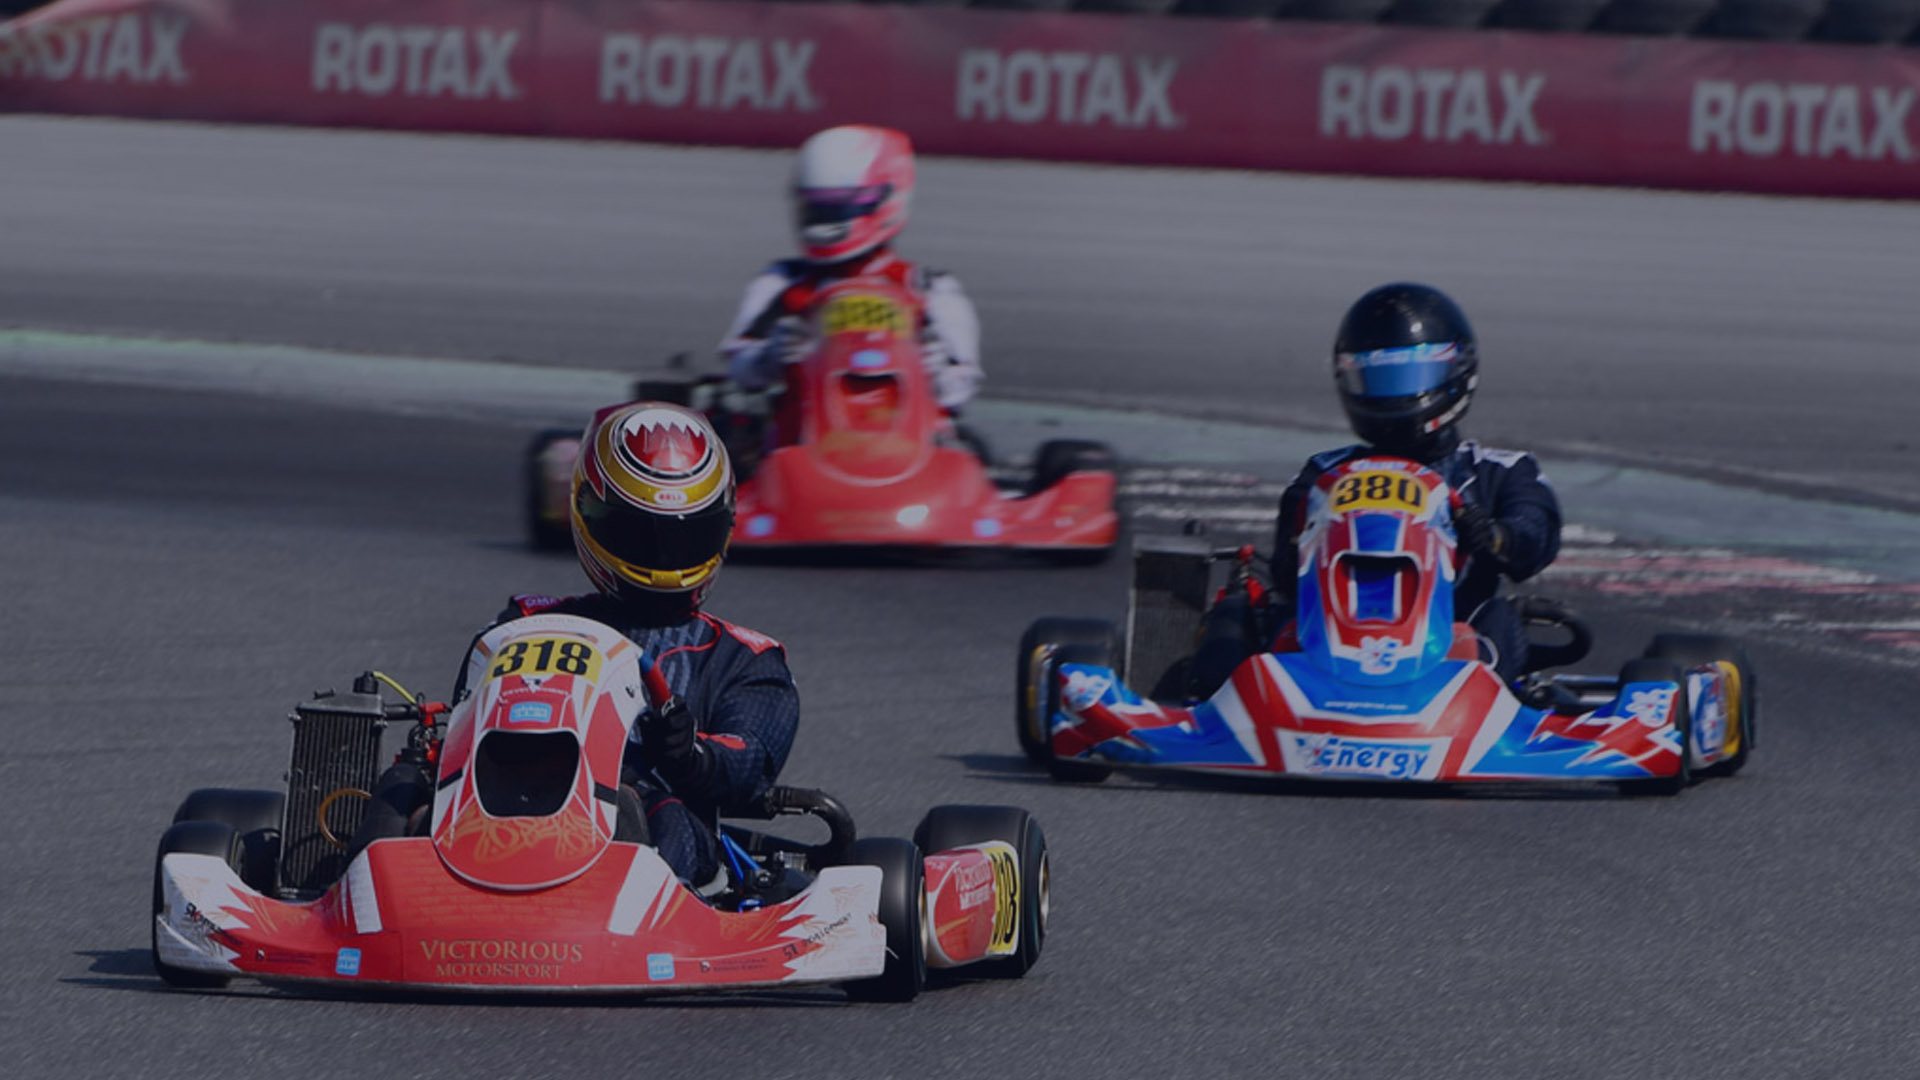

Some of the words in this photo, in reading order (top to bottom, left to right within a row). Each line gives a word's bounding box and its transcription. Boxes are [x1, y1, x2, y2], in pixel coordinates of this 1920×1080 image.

[312, 24, 518, 98] ROTAX
[600, 33, 817, 109] ROTAX
[955, 49, 1182, 127] ROTAX
[1319, 65, 1546, 145] ROTAX
[1689, 79, 1916, 160] ROTAX
[1335, 474, 1421, 506] 380
[493, 640, 592, 677] 318
[1316, 737, 1428, 776] Energy
[420, 939, 583, 963] VICTORIOUS
[436, 962, 563, 979] MOTORSPORT
